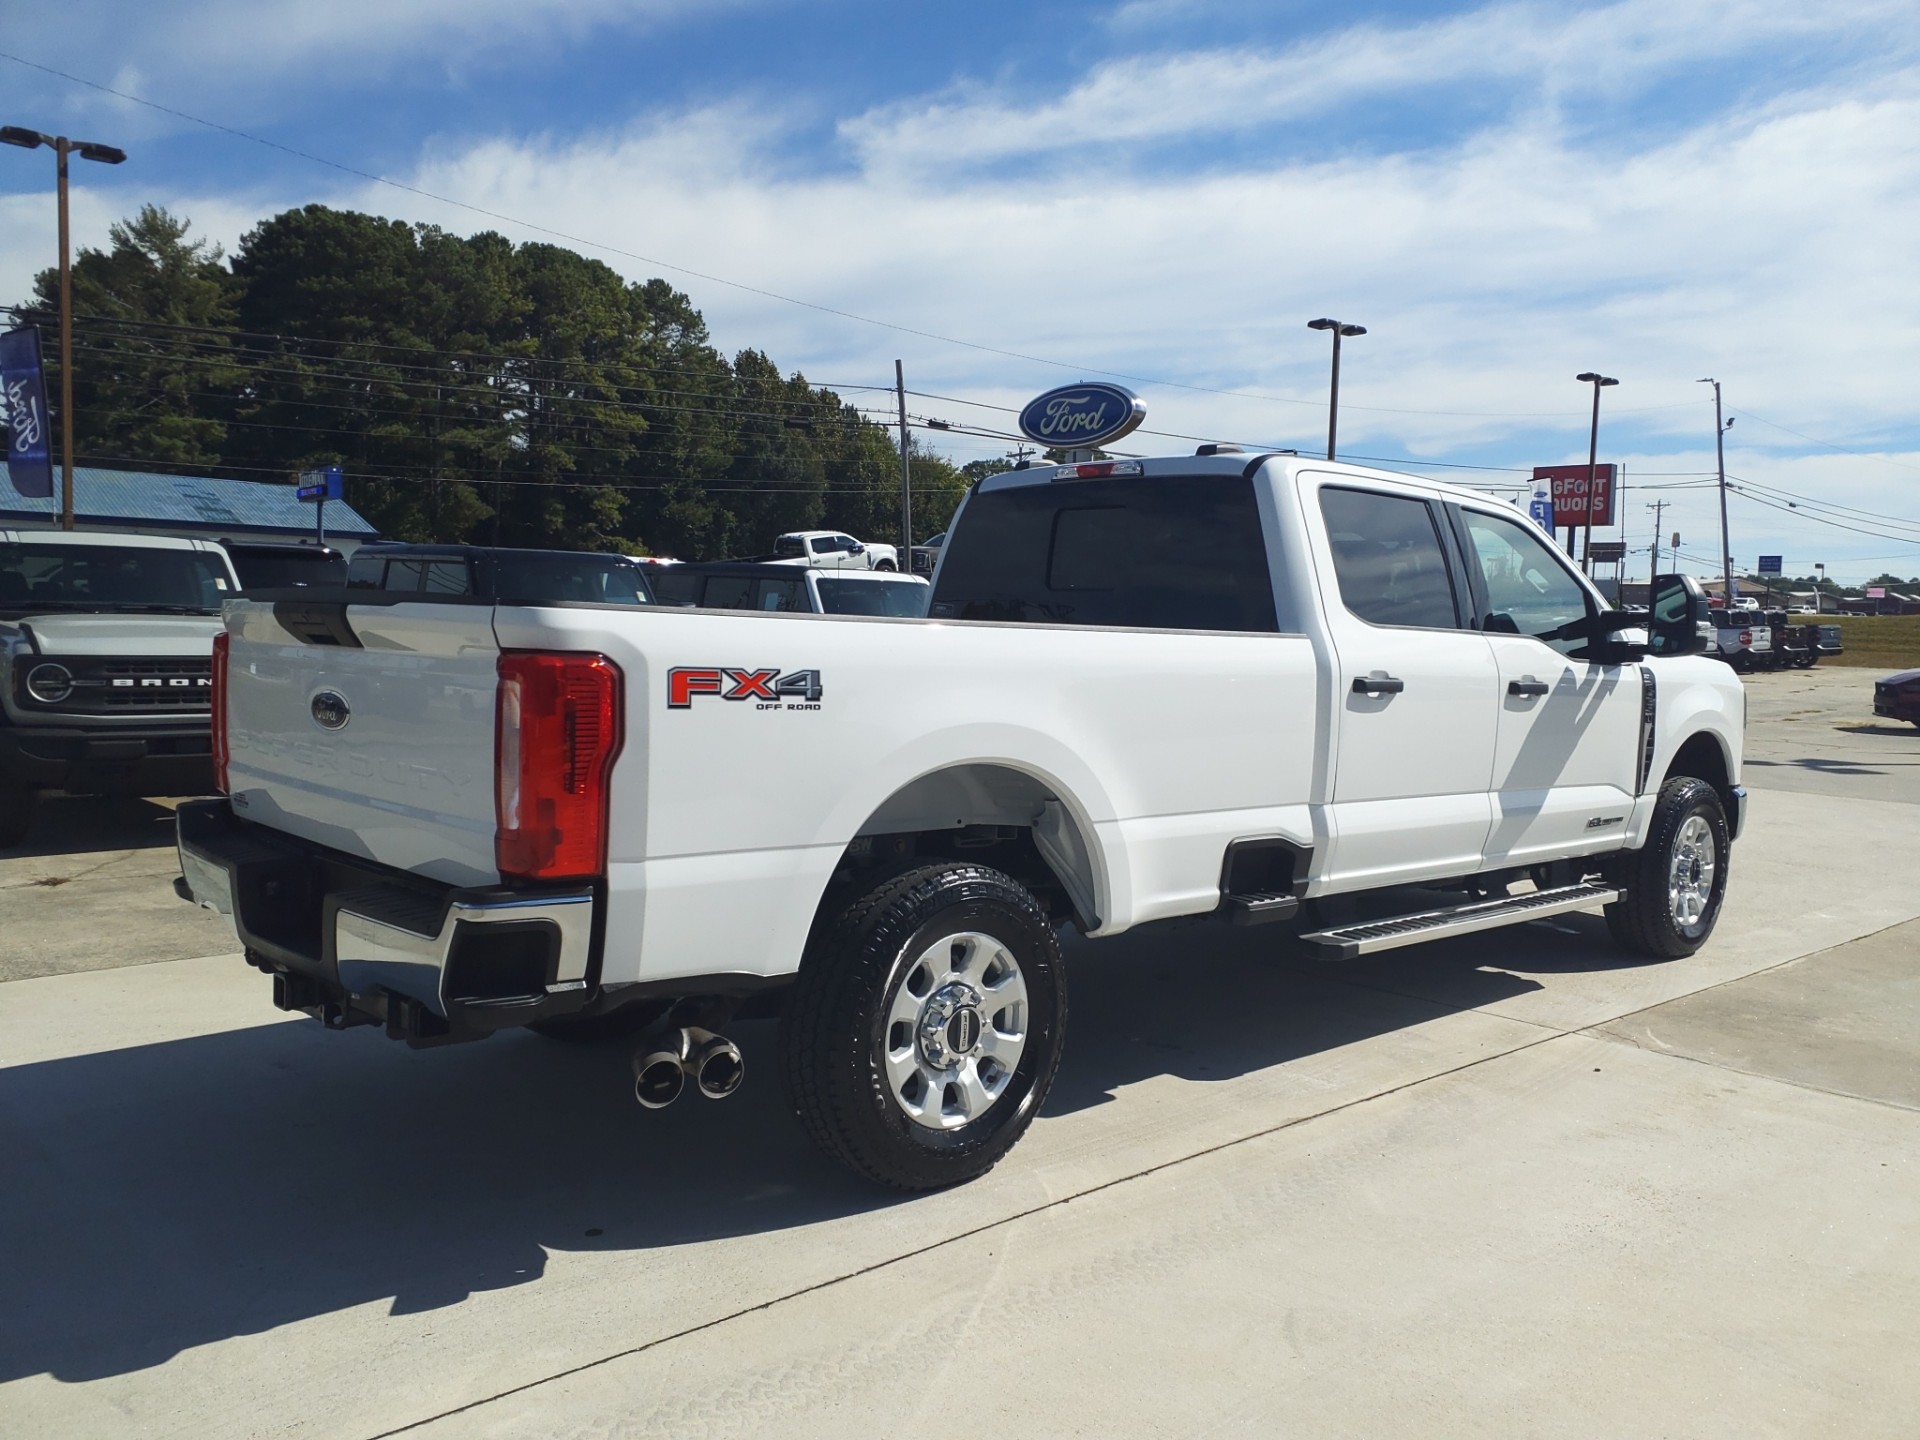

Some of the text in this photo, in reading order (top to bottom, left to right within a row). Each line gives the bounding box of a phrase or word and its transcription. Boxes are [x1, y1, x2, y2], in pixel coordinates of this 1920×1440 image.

[1040, 396, 1107, 435] Ford
[667, 666, 823, 710] FX4
[787, 703, 822, 711] ROAD
